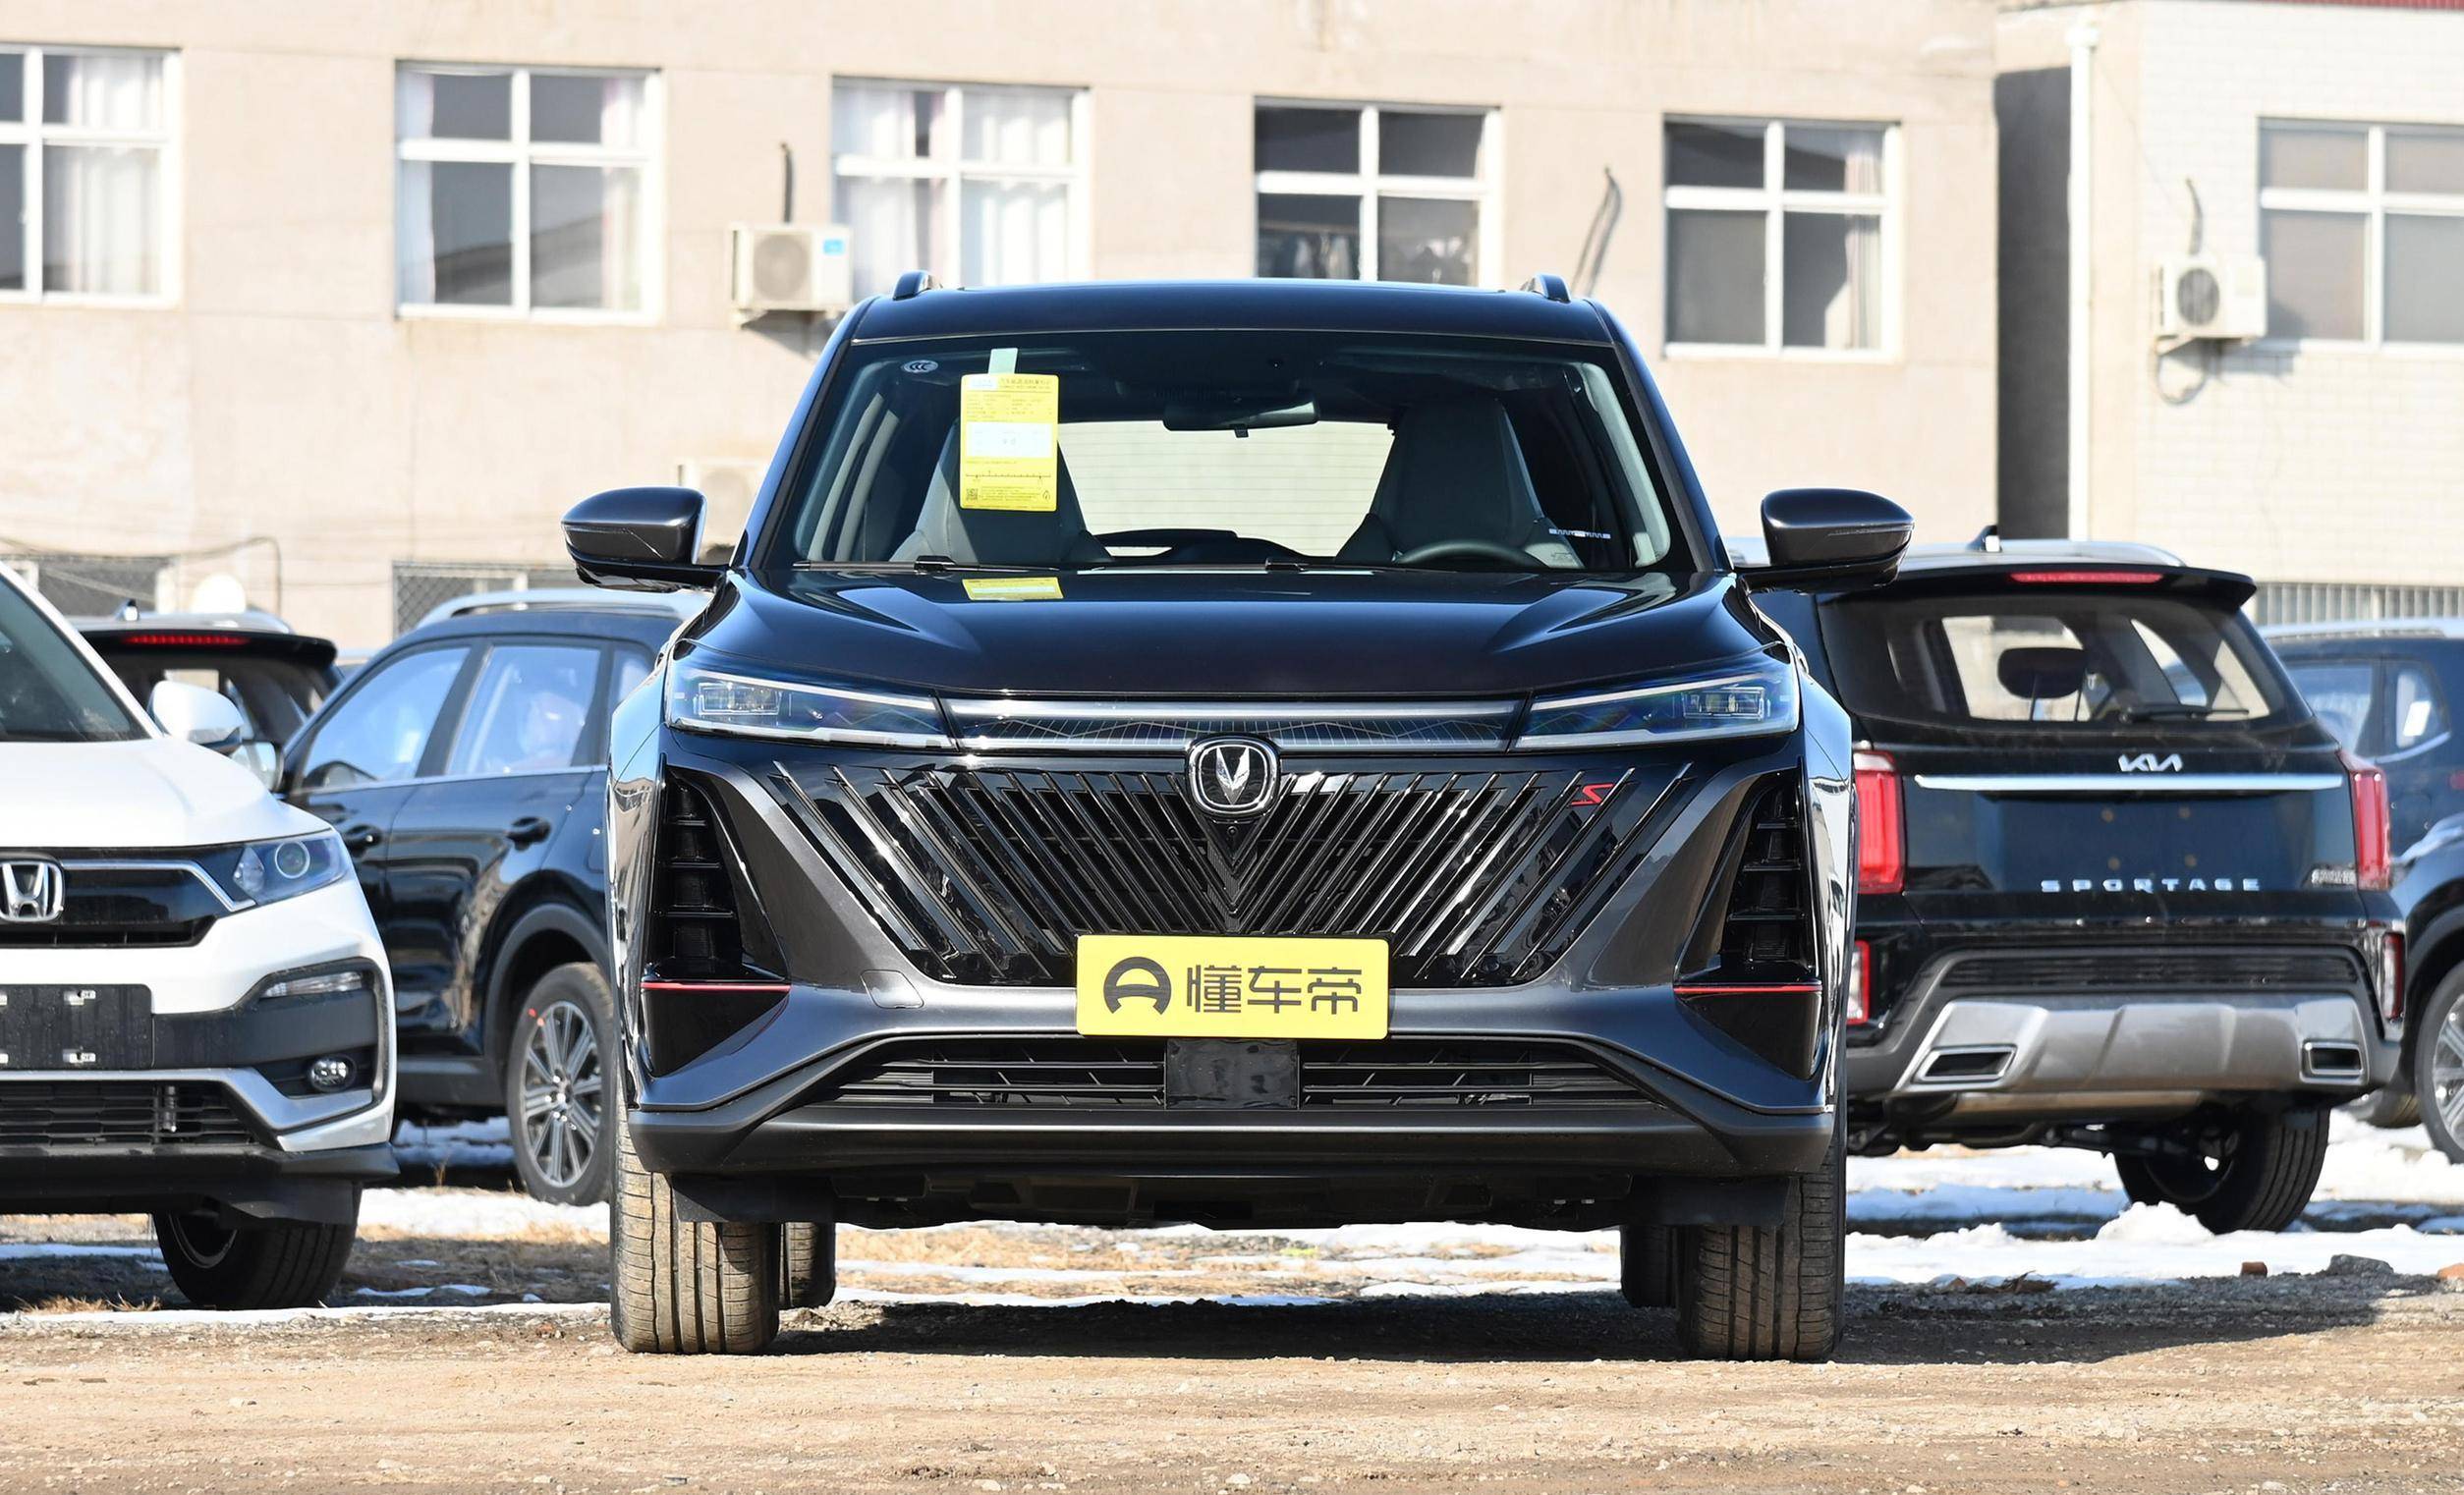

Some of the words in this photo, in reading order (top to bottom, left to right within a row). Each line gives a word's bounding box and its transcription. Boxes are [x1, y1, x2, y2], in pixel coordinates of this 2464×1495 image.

[2118, 753, 2183, 772] KIA
[2041, 878, 2260, 894] SPORTAGE
[1187, 964, 1362, 1016] 懂车帝
